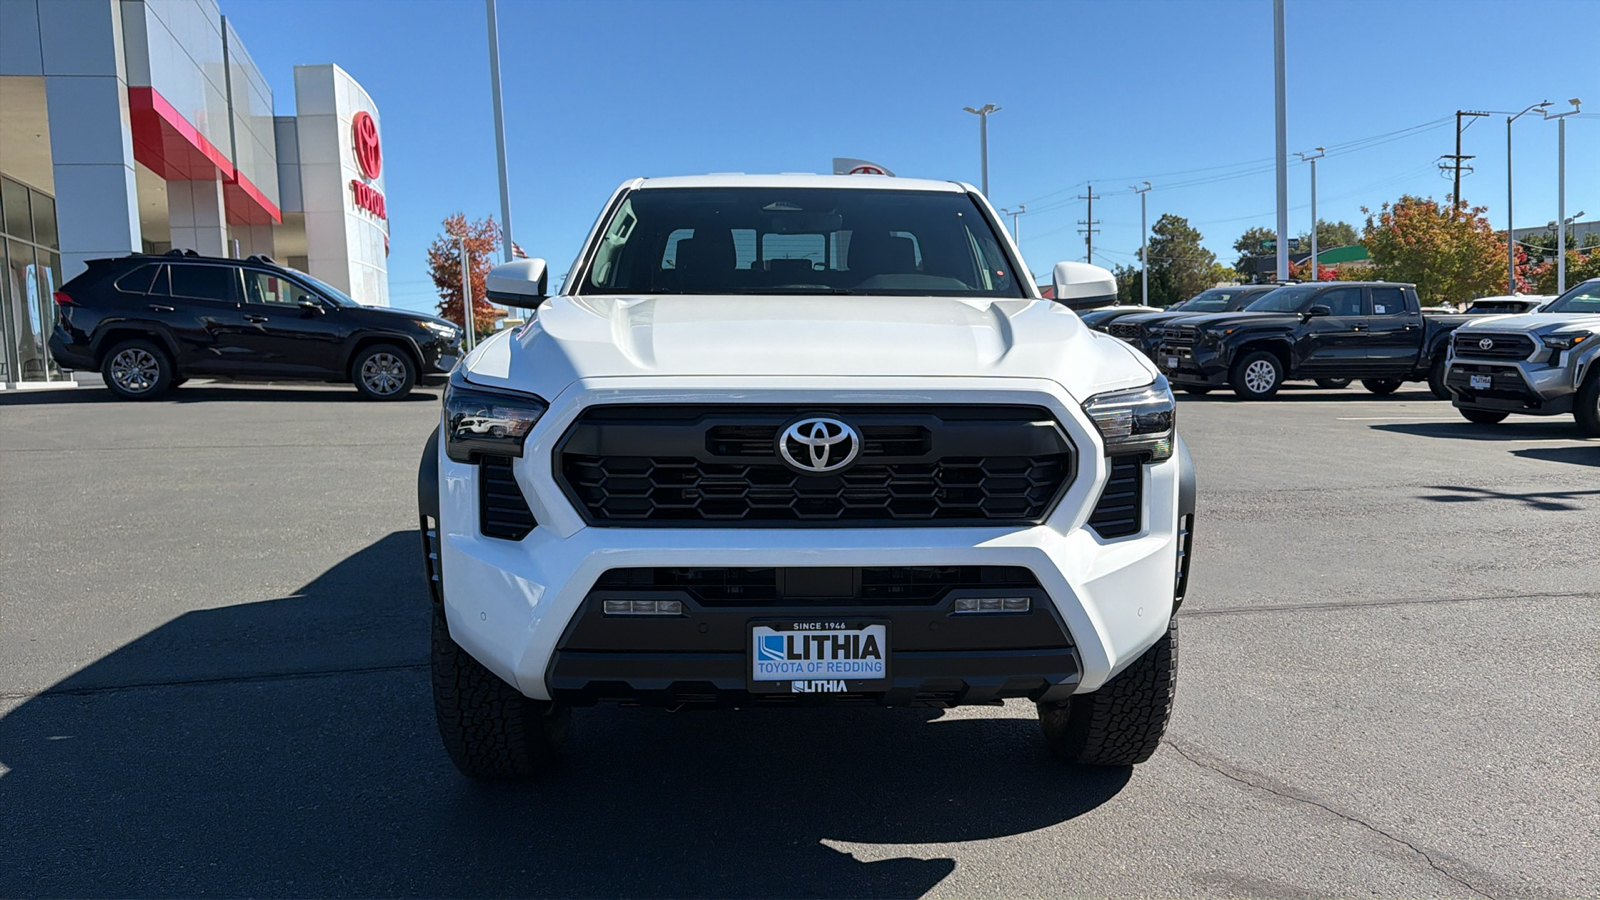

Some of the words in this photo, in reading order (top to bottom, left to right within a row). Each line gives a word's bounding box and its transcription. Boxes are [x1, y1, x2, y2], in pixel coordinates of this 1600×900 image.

[351, 179, 386, 220] TOYOTA
[793, 622, 821, 630] SINCE
[825, 622, 846, 630] 1946
[787, 634, 881, 660] LITHIA
[758, 662, 804, 673] TOYOTA
[807, 662, 823, 672] OF
[826, 661, 882, 672] REDDING
[804, 680, 847, 692] LITHIA
